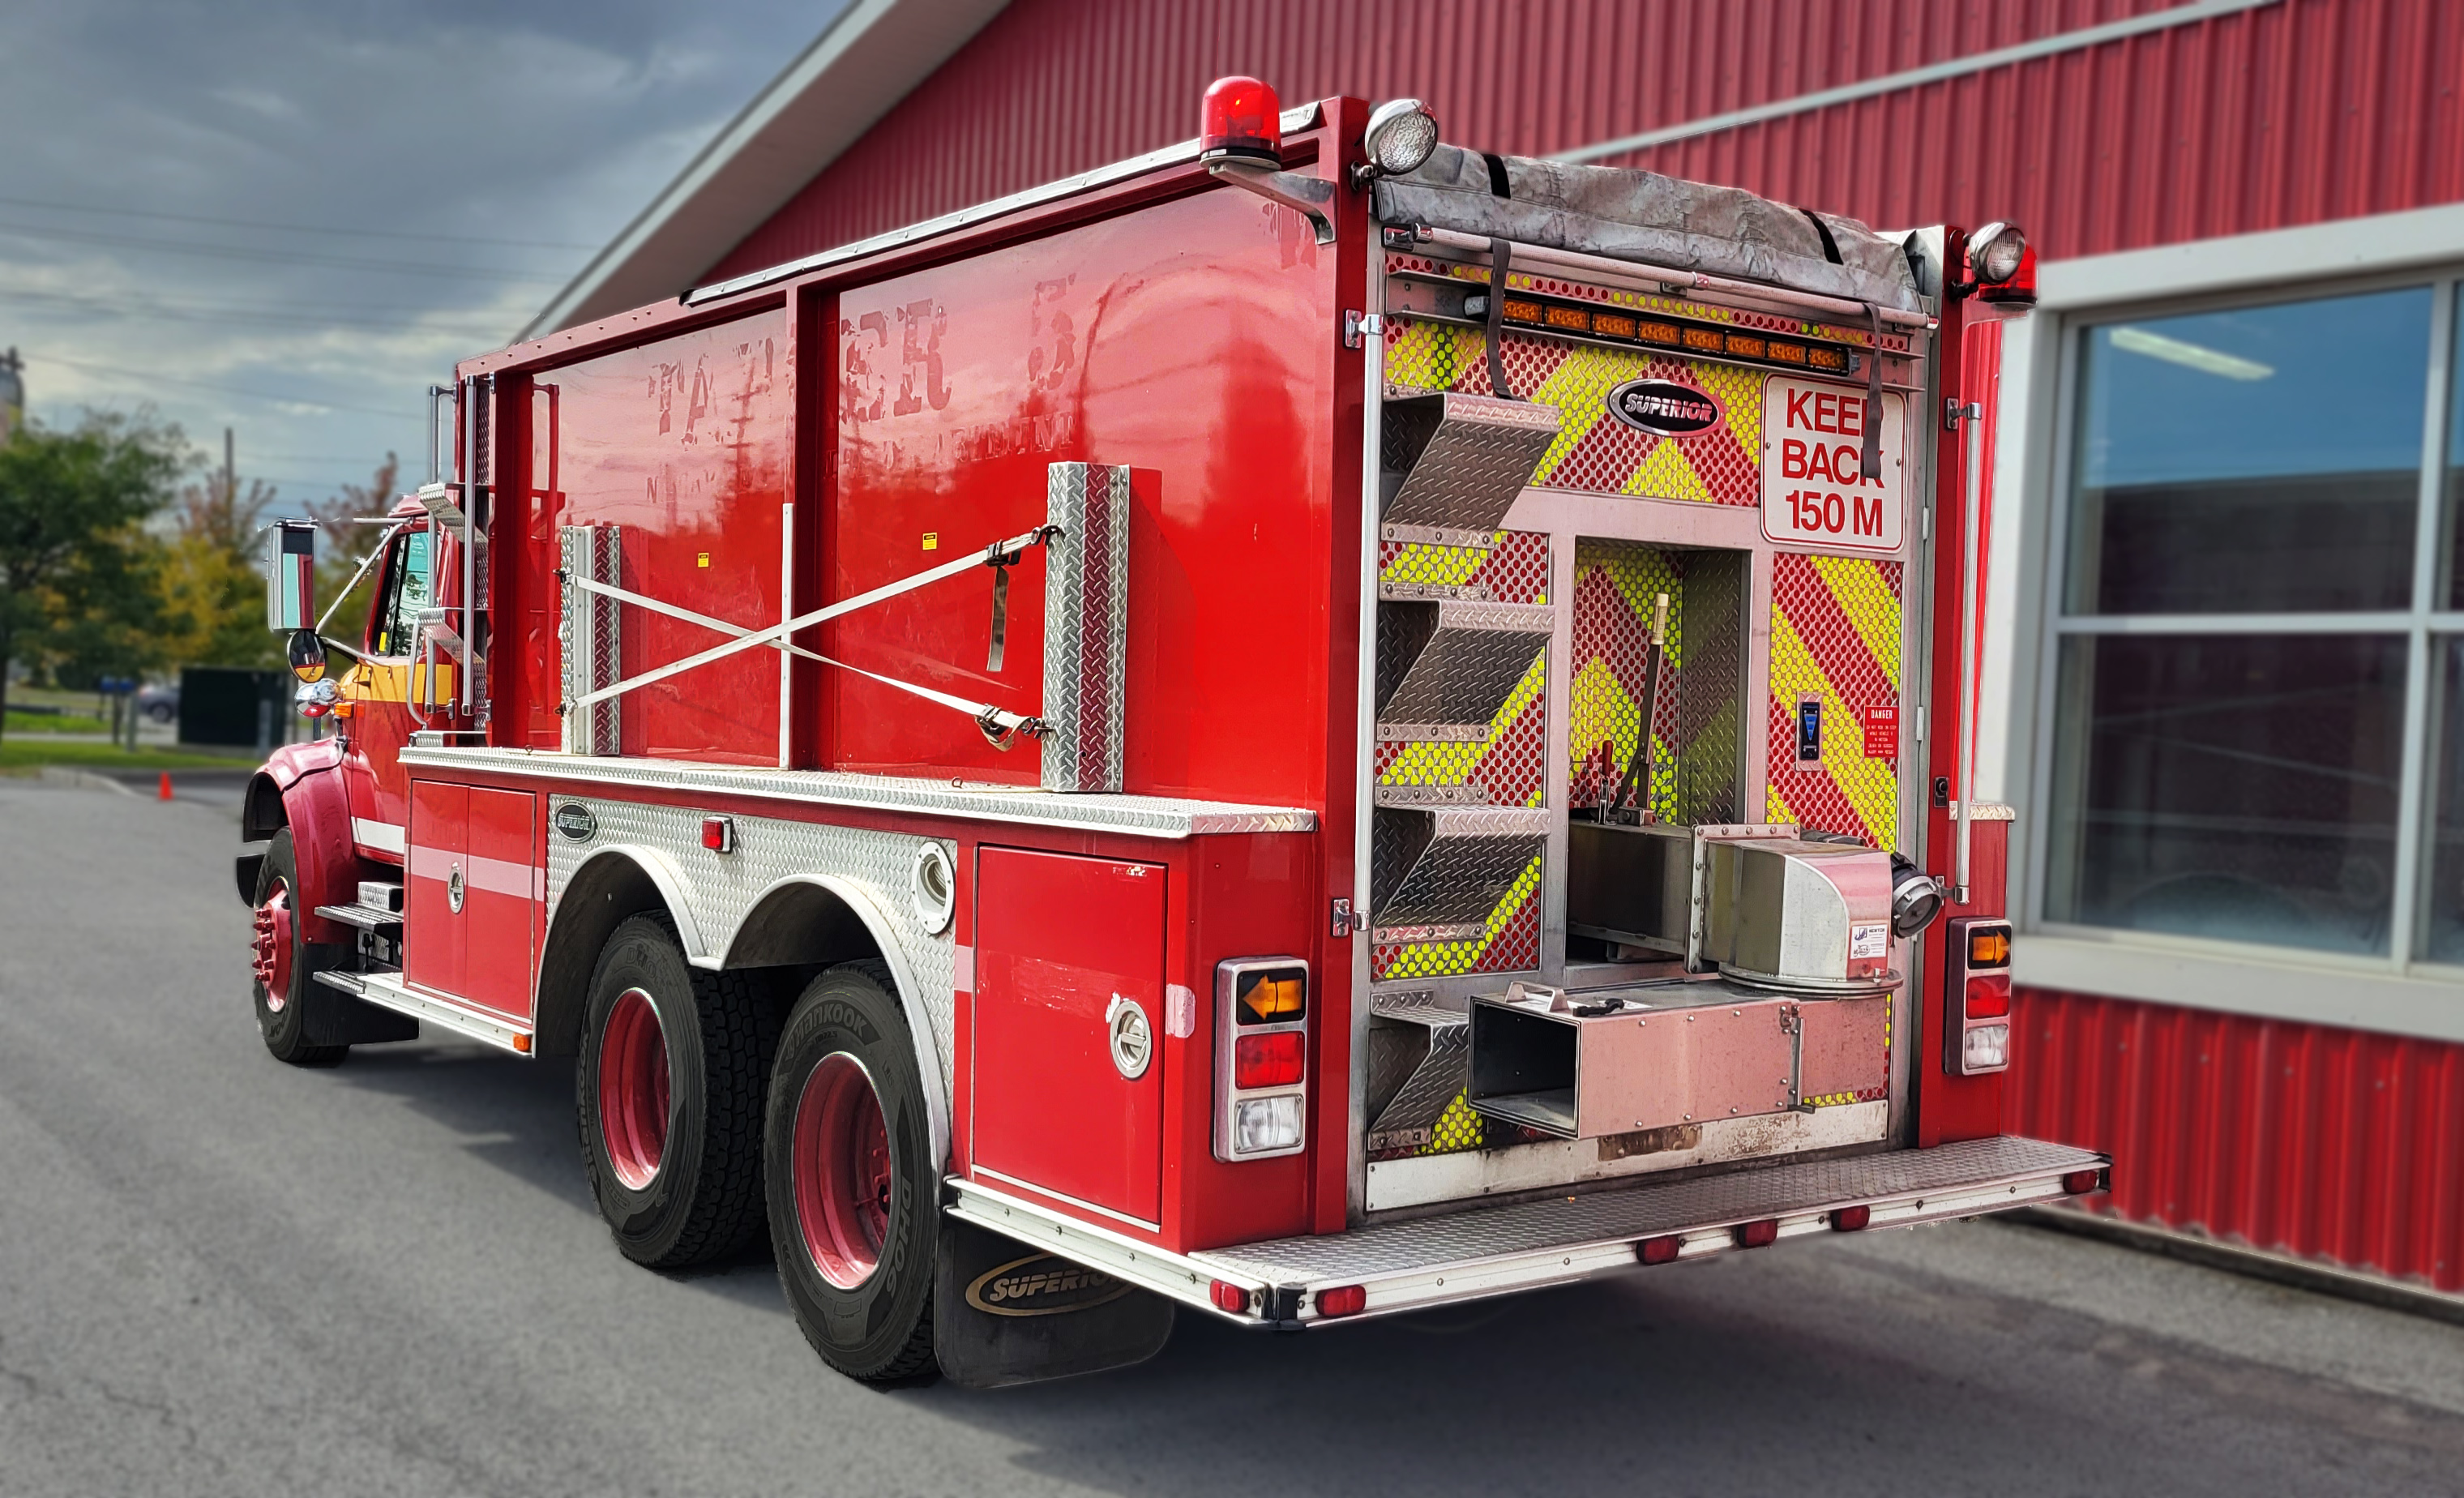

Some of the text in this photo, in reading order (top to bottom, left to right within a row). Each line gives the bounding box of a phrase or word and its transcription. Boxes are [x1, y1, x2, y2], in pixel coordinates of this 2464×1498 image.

[1625, 392, 1712, 422] SUPERIOR
[1786, 490, 1883, 537] 150 M
[1871, 709, 1893, 719] DANGER
[557, 812, 590, 831] SUPERIOR
